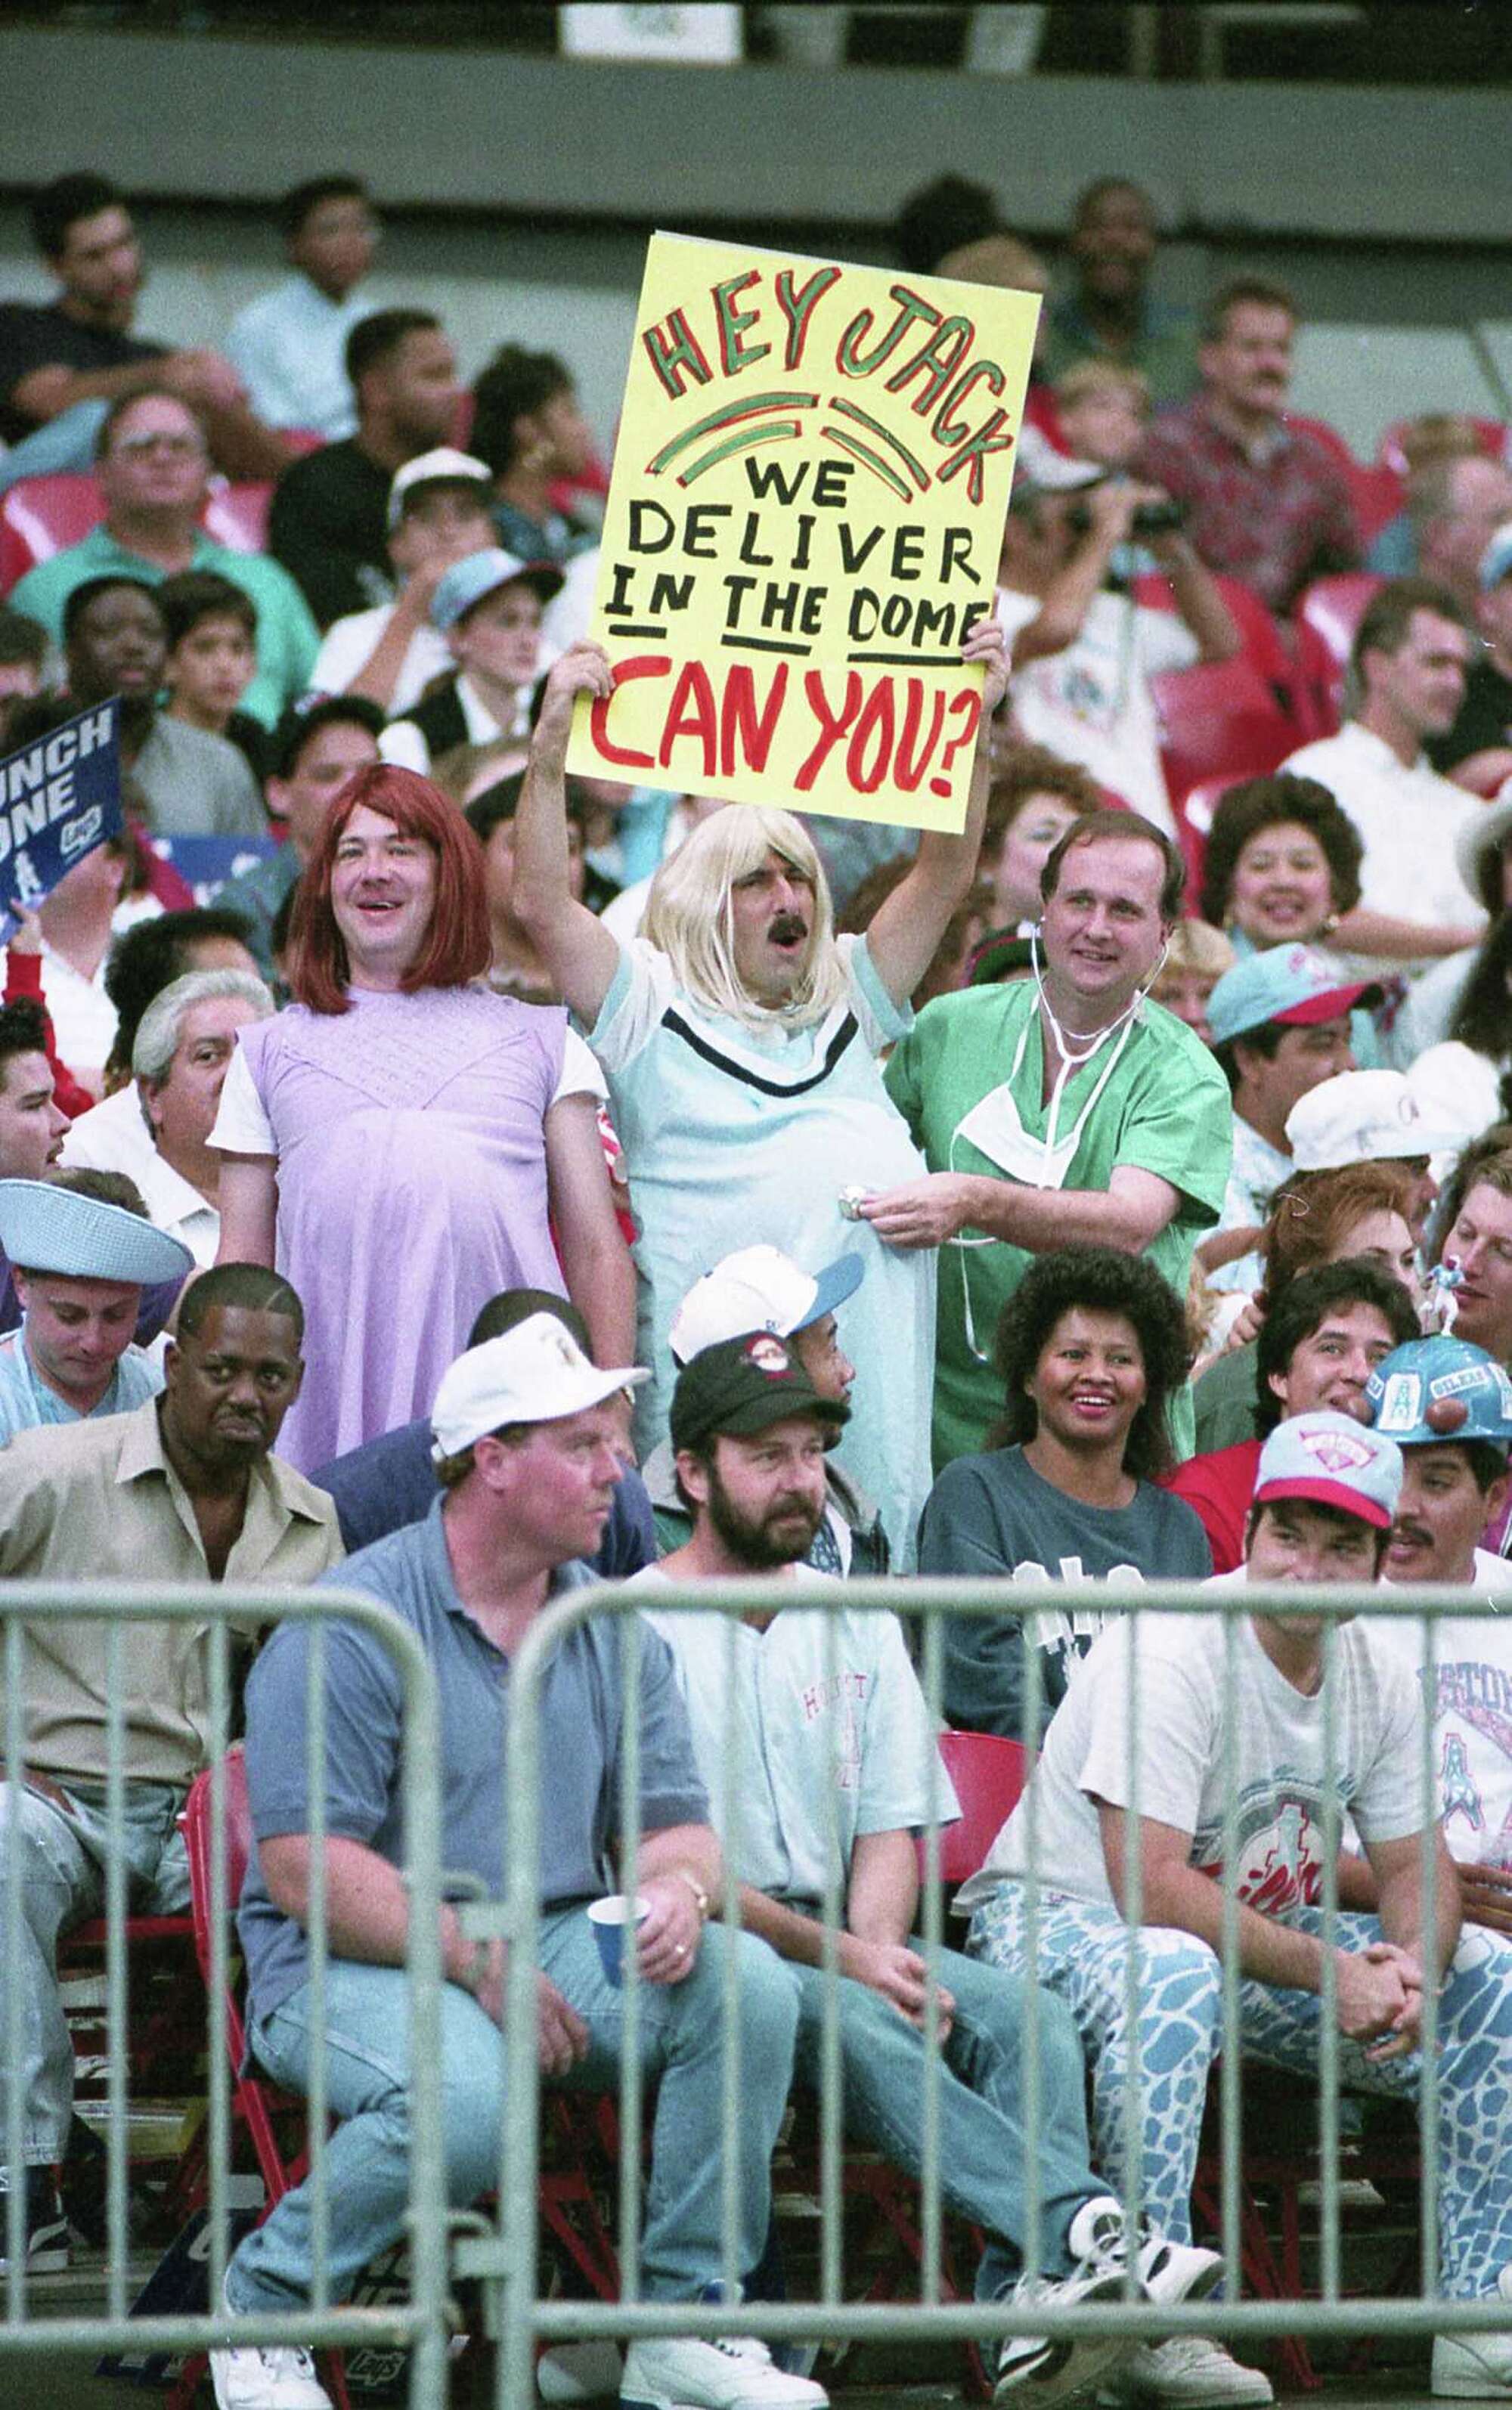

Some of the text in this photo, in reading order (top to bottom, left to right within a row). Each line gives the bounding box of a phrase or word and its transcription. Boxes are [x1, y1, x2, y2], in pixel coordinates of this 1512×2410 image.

[643, 267, 1013, 506] HEY JACK
[745, 456, 855, 508] WE
[628, 500, 981, 585] DELIVER
[604, 564, 990, 648] IN THE DOME
[0, 708, 112, 809] NCH
[590, 655, 981, 798] CAN YOU?
